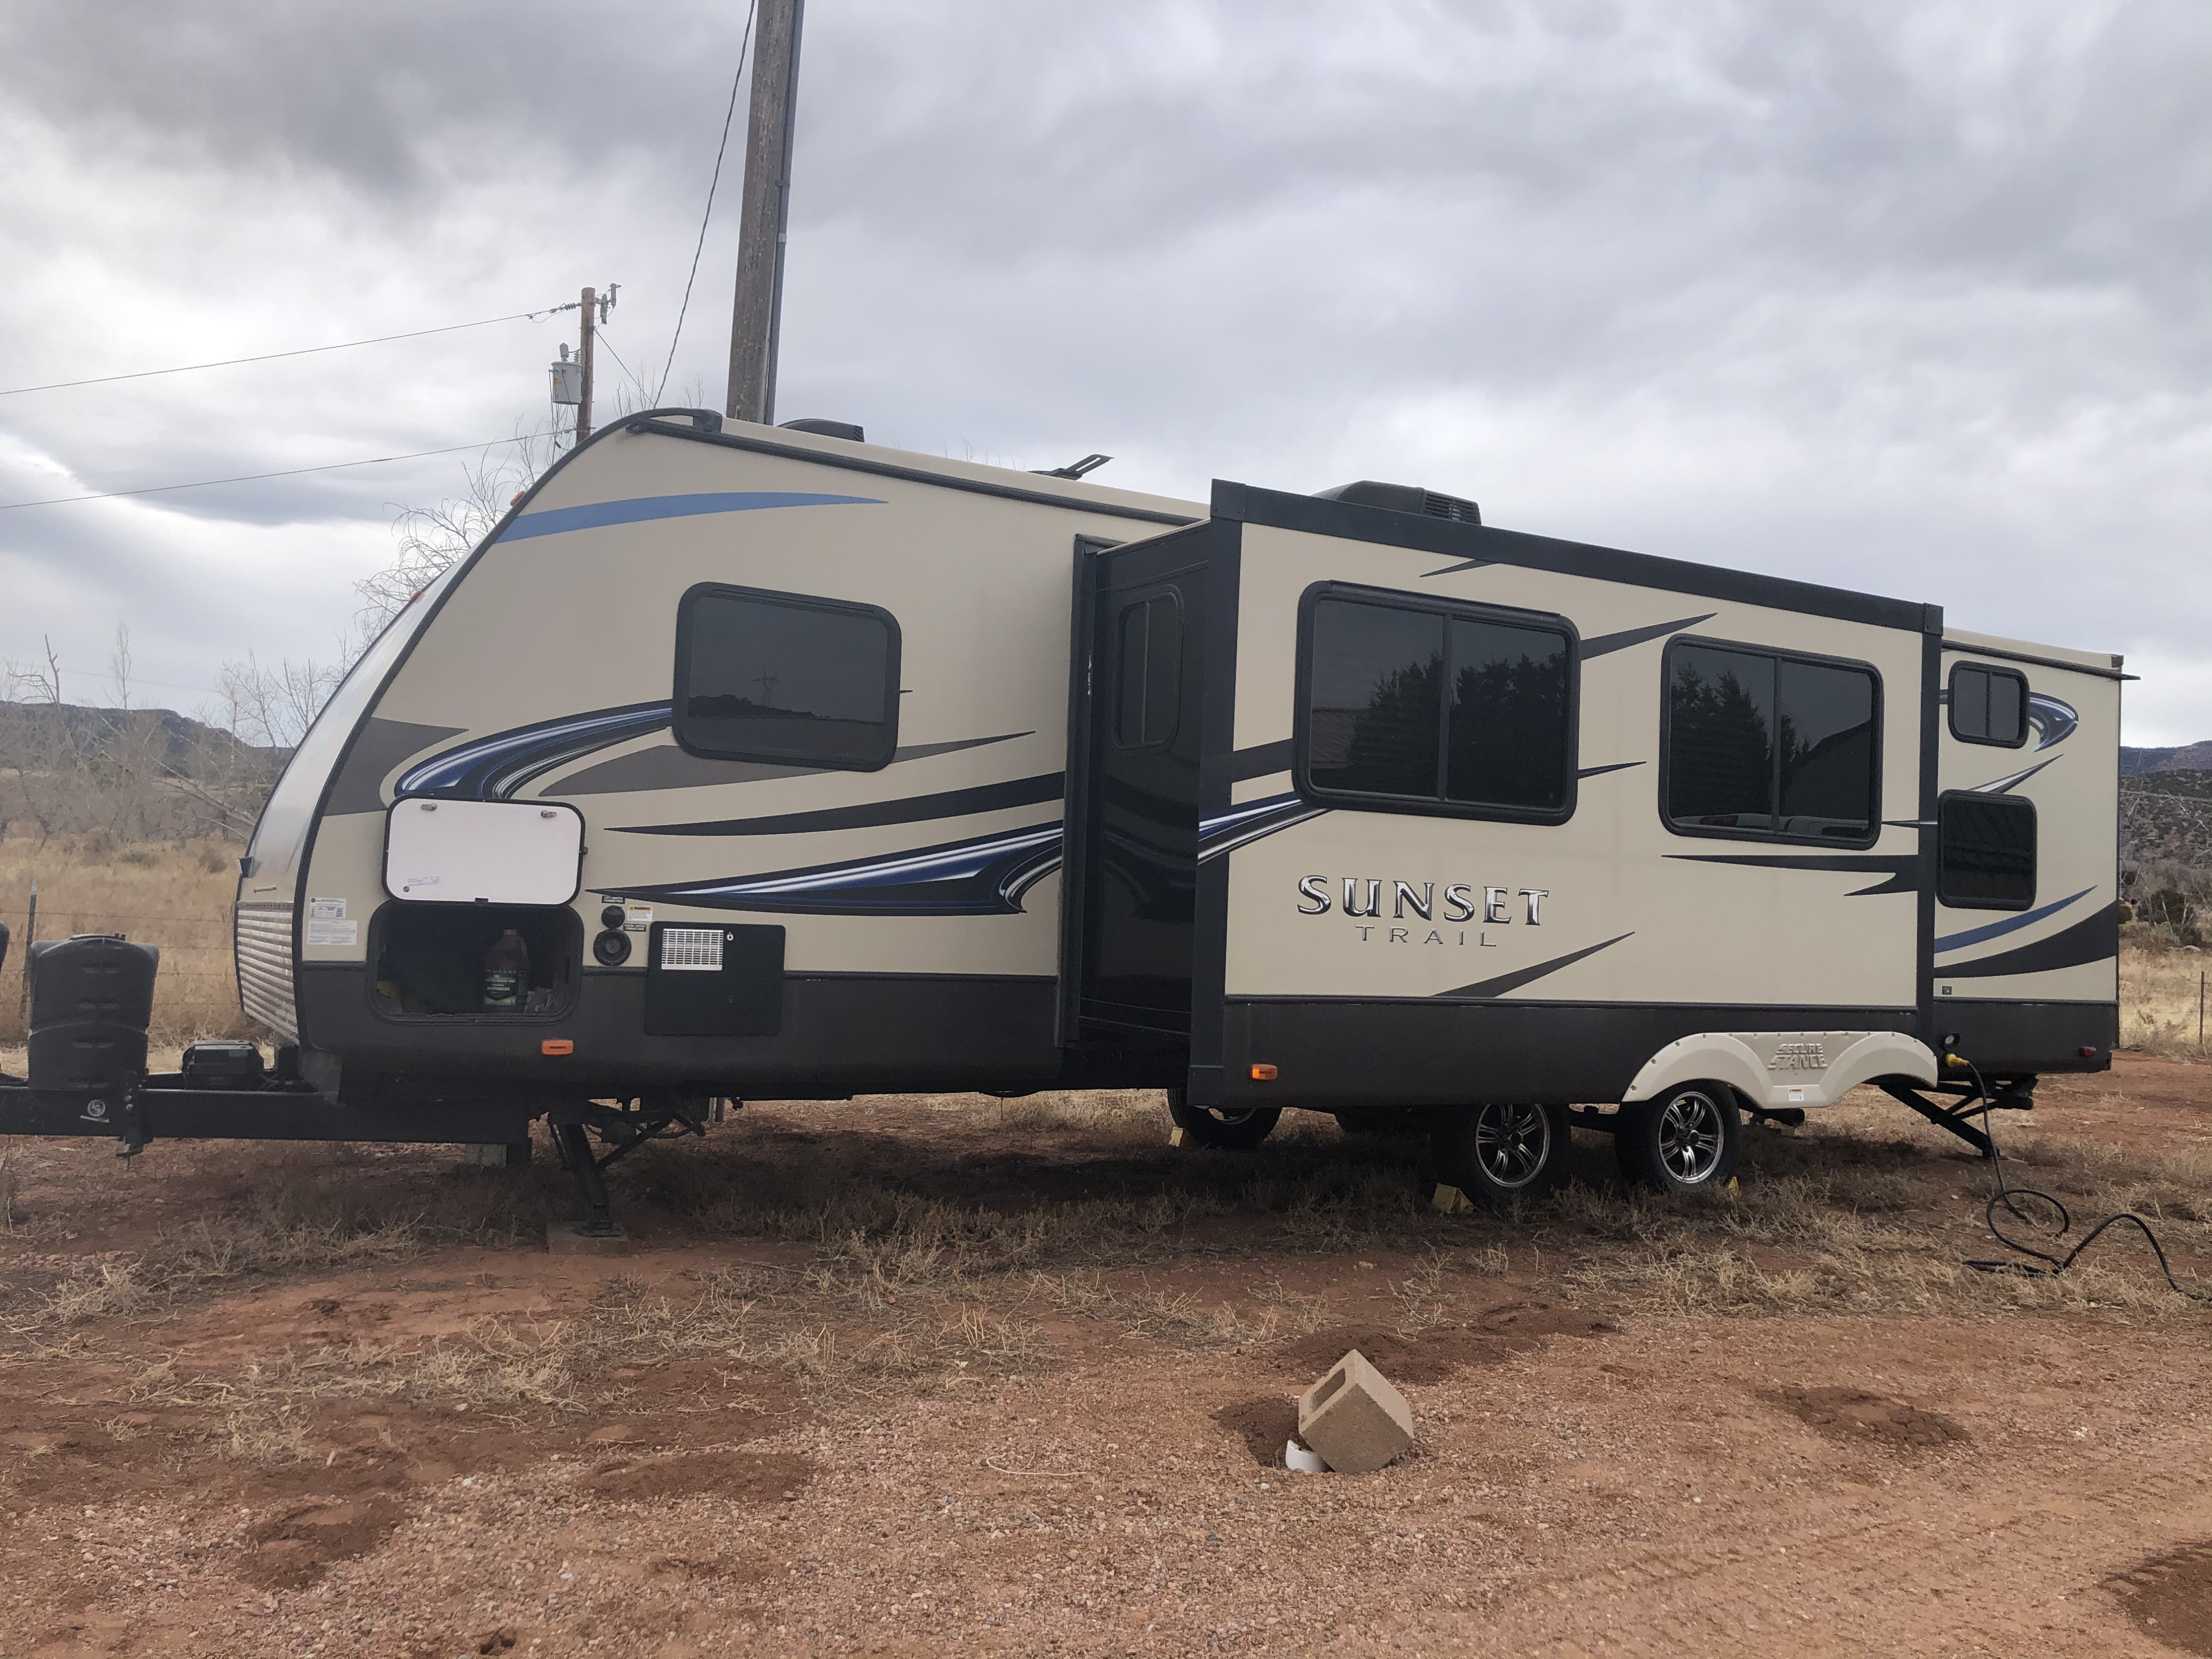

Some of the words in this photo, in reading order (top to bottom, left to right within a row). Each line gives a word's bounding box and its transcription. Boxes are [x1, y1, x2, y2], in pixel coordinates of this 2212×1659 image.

[1297, 875, 1549, 926] SUNSET
[1355, 925, 1496, 947] TRAIL
[1776, 1043, 1823, 1055] SECURE
[1768, 1054, 1828, 1070] STANCE
